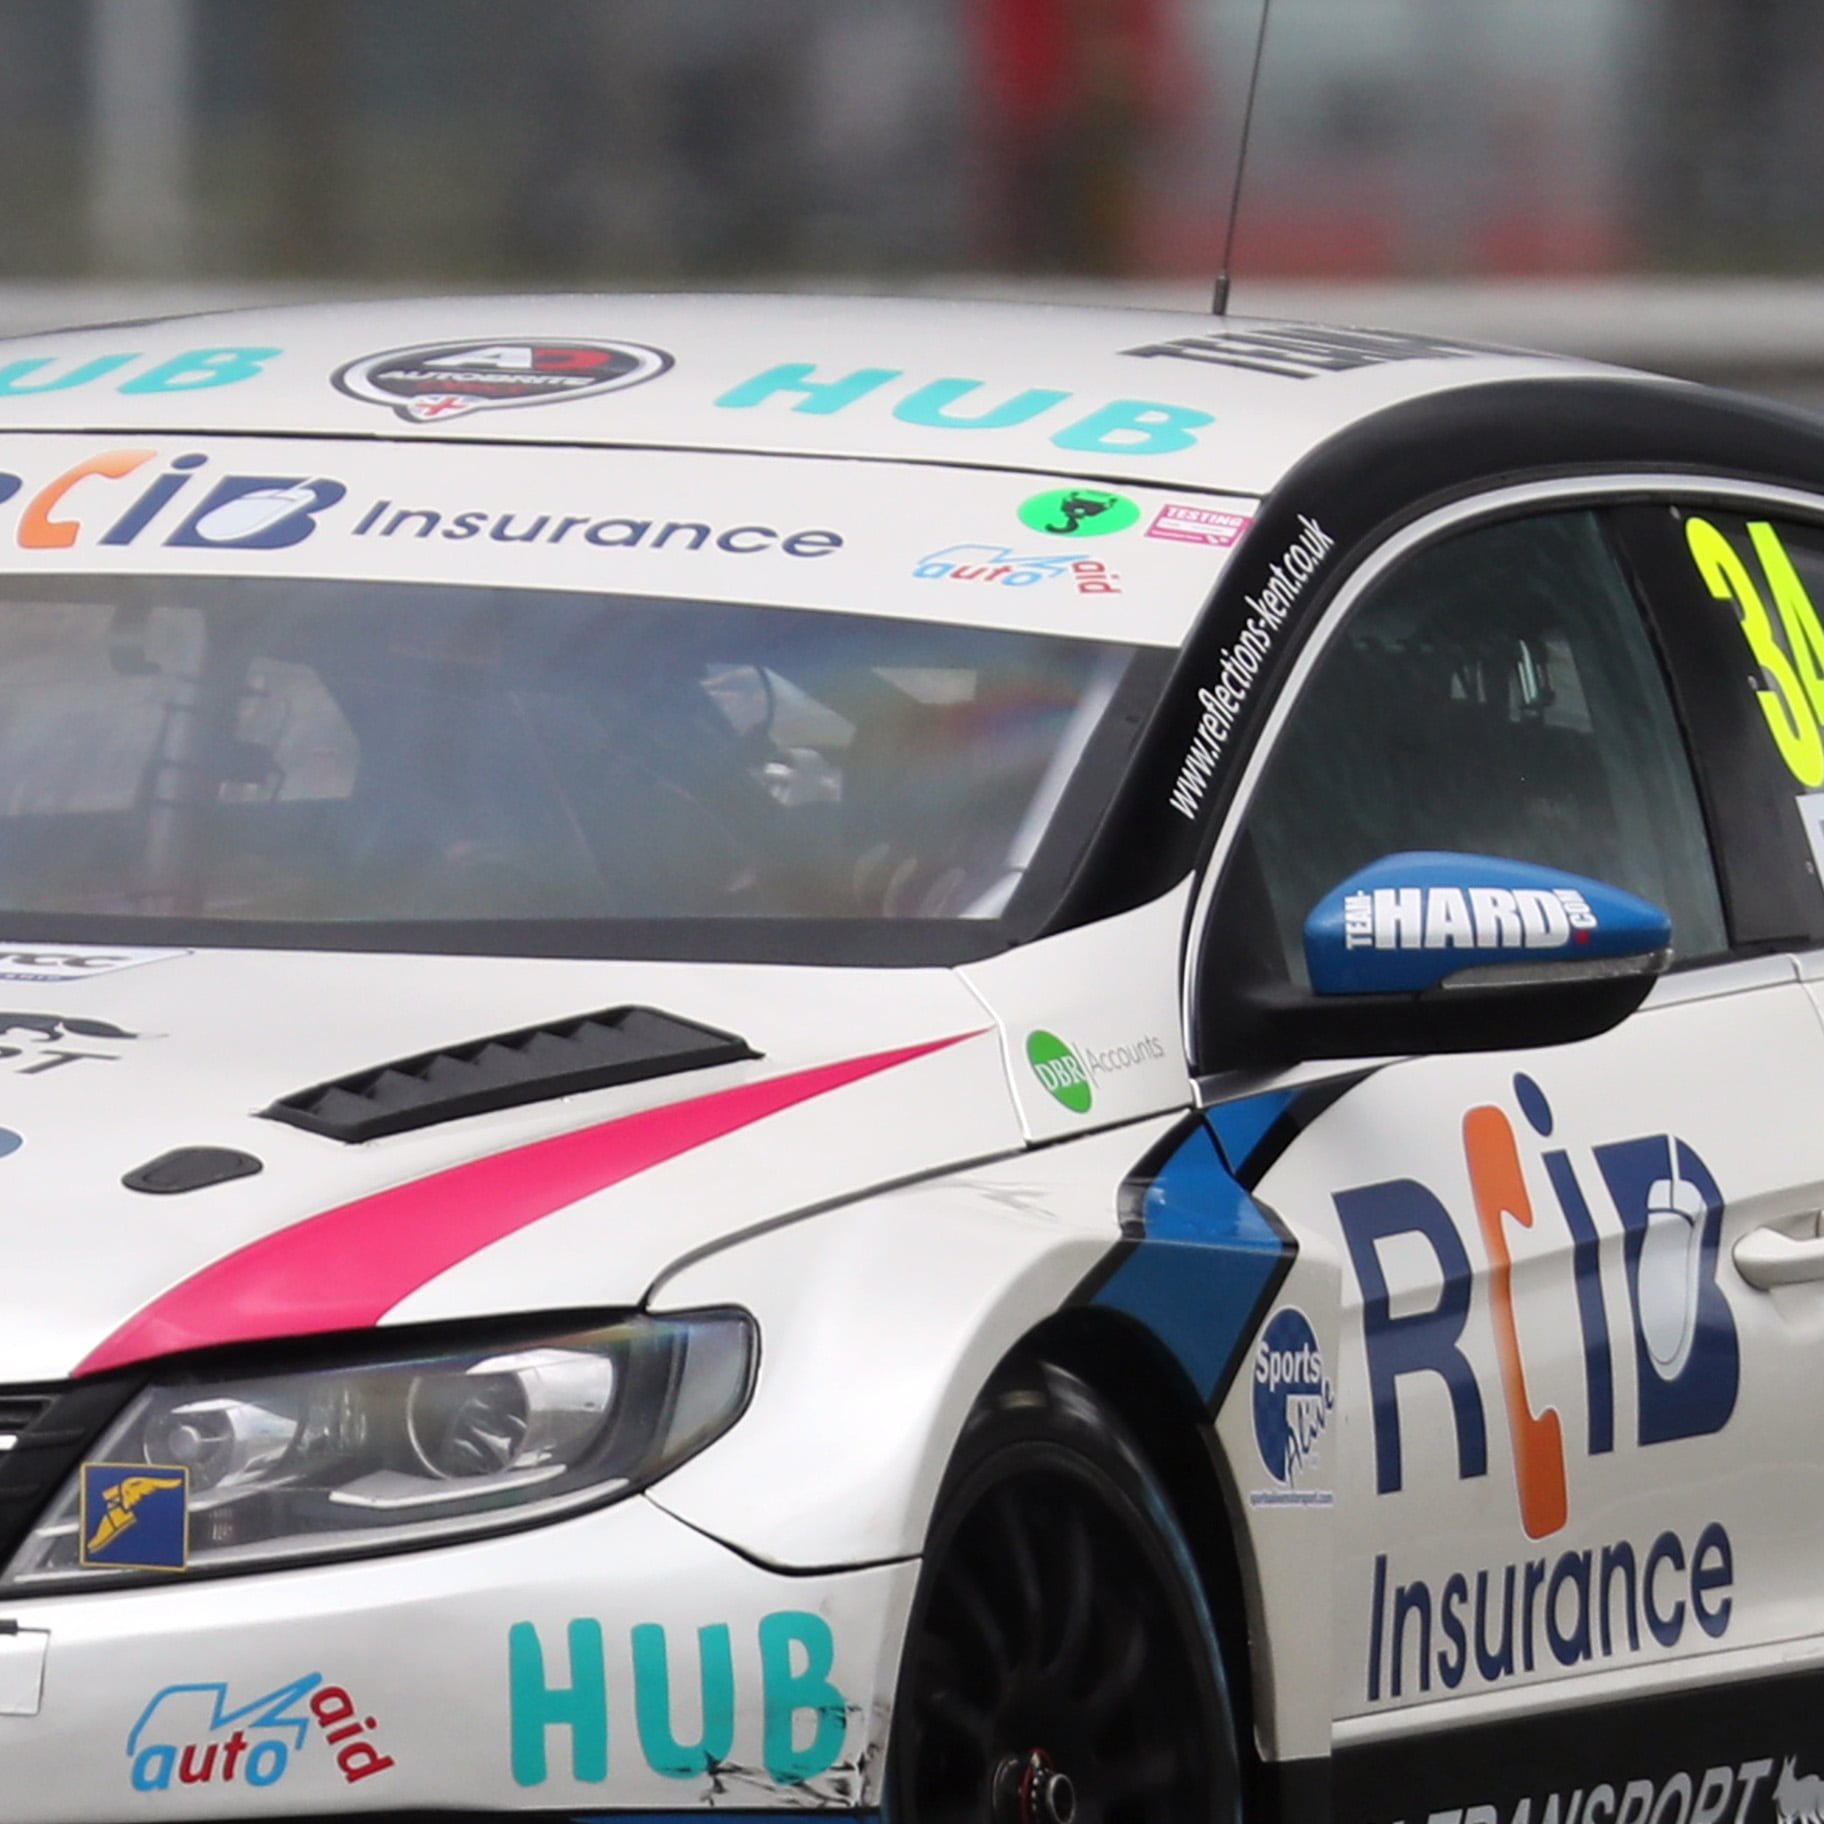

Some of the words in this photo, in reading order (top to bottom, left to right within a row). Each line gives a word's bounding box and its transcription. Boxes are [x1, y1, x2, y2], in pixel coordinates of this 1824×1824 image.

[713, 362, 1216, 454] HUB
[352, 500, 844, 557] Insurance
[1167, 507, 1244, 527] TESTING
[912, 561, 1042, 586] auto
[1170, 514, 1335, 822] www.reflections-kent.co.uk
[1373, 887, 1570, 949] HARD
[1085, 1034, 1165, 1072] Accounts
[1255, 1341, 1323, 1393] Sports
[1367, 1521, 1734, 1702] Insurance
[509, 1610, 848, 1787] HUB
[131, 1731, 289, 1793] auto
[308, 1685, 395, 1783] aid
